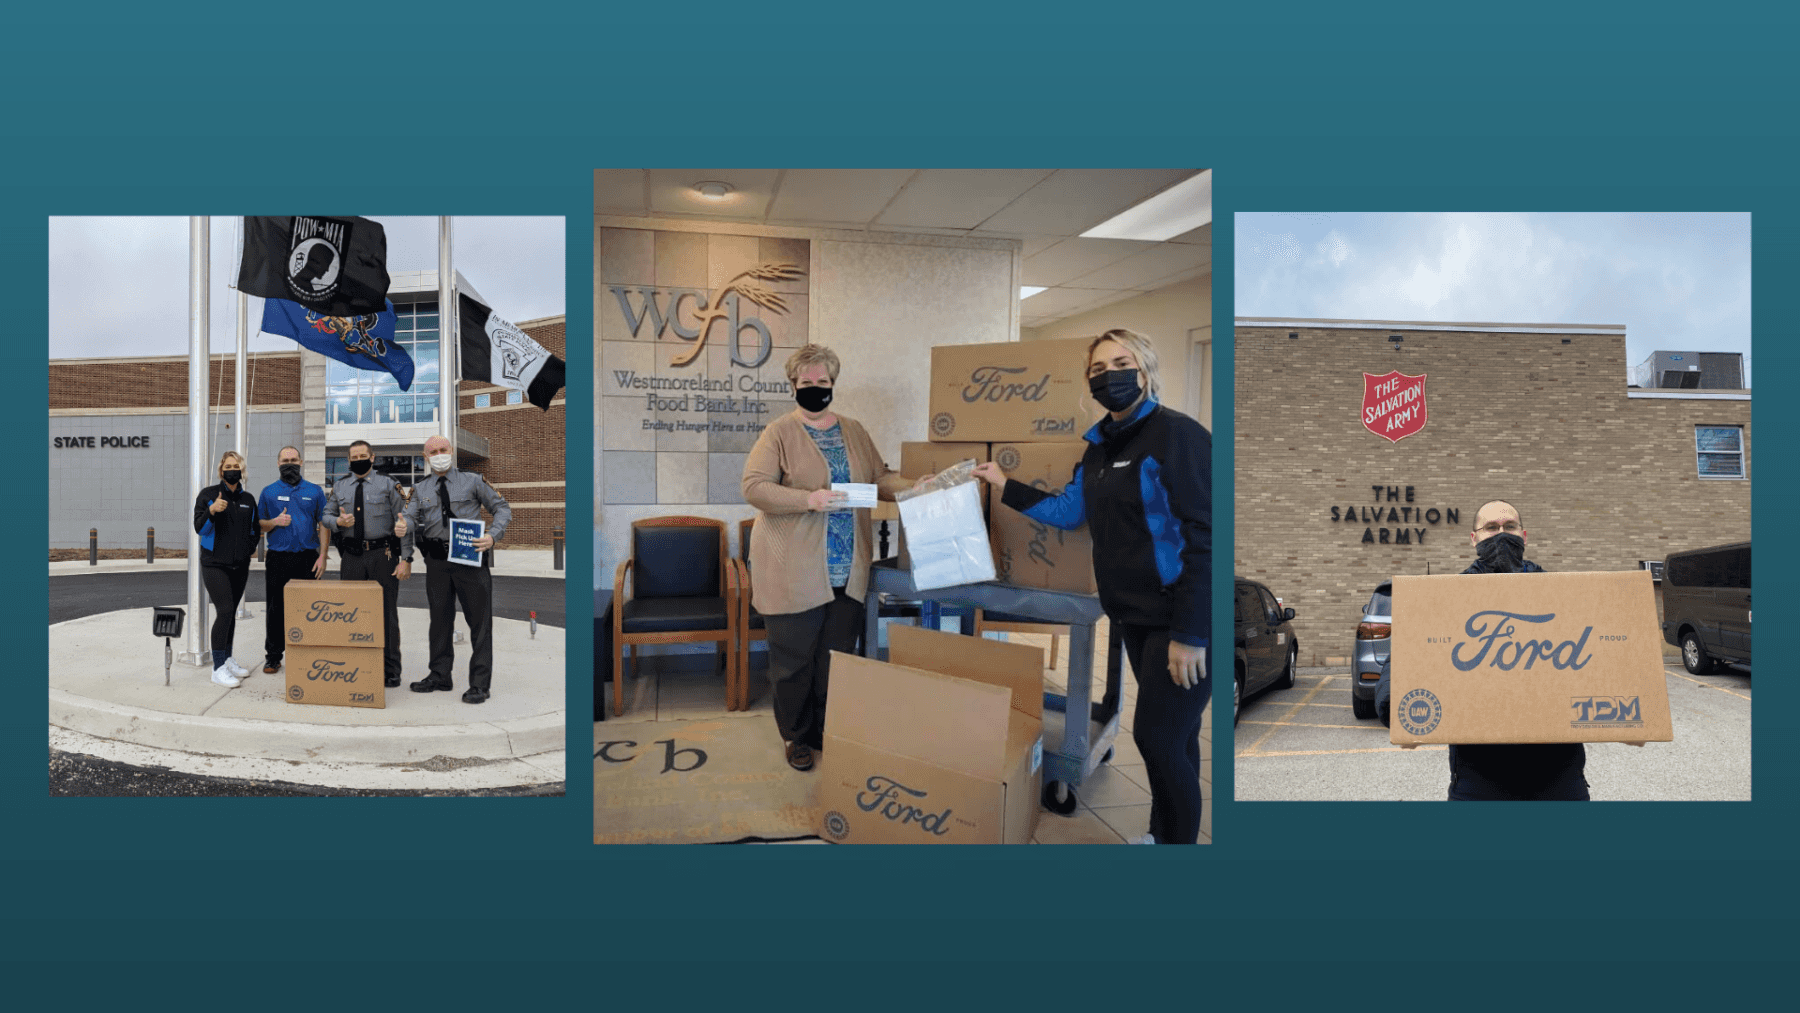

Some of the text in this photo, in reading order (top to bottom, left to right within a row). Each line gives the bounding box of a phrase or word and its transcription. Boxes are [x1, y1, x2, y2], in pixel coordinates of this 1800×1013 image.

[291, 216, 345, 254] POW MIA
[613, 369, 734, 392] Westmoreland
[961, 366, 1051, 403] Ford
[1374, 377, 1401, 399] THE
[646, 392, 770, 416] Food Bank, Inc.
[1365, 381, 1423, 424] SALVATION
[642, 419, 674, 433] Ending
[676, 420, 710, 434] Hunger
[1386, 401, 1421, 433] ARMY
[53, 435, 151, 449] STATE POLICE
[1372, 485, 1416, 503] THE
[1330, 505, 1459, 525] SALVATION
[458, 527, 474, 535] Mask
[1361, 527, 1427, 545] ARMY
[306, 600, 359, 623] Ford
[1427, 610, 1628, 672] BUILT Ford PROUD
[307, 659, 360, 683] Ford
[1411, 706, 1429, 717] UAW
[1570, 695, 1642, 721] TDM
[856, 775, 953, 836] Ford
